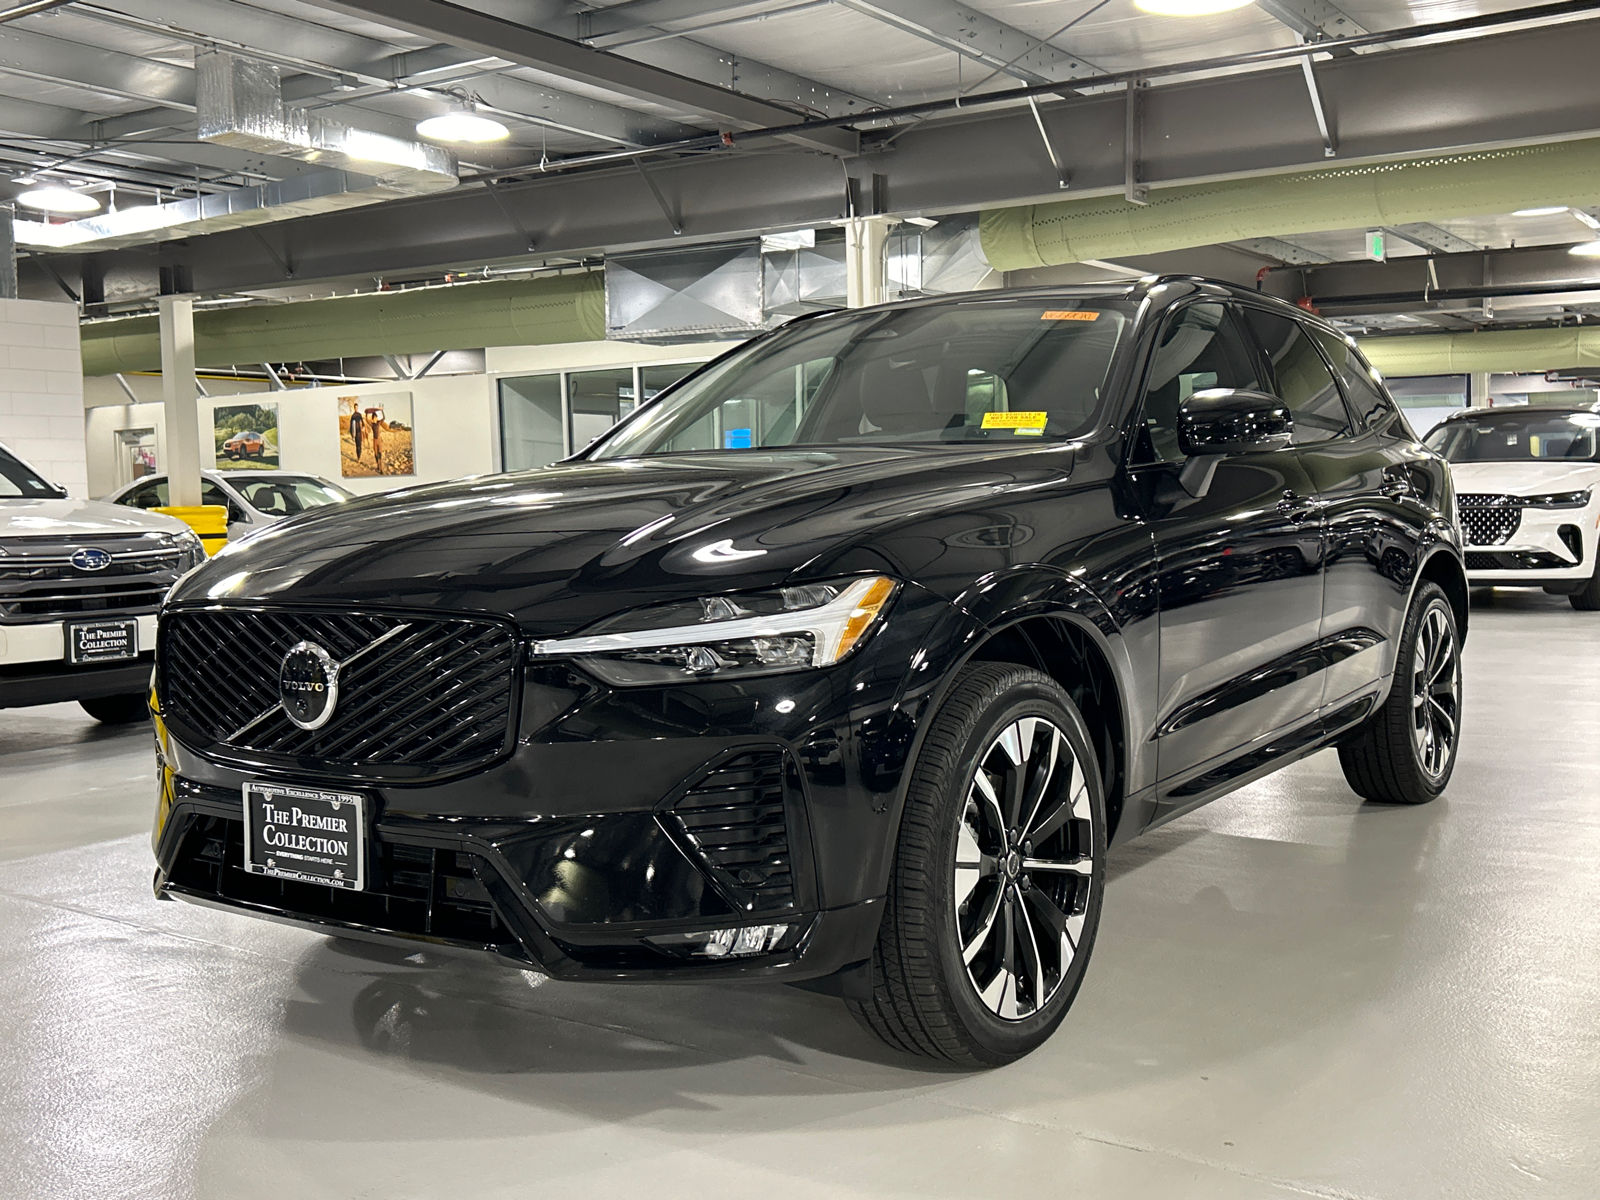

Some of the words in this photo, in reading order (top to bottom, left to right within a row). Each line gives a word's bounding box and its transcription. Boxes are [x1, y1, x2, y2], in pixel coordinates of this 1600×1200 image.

[80, 631, 96, 640] THE
[96, 630, 127, 639] PREMIER
[80, 638, 128, 650] COLLECTION
[283, 680, 325, 692] VOLVO
[262, 803, 290, 825] THE
[291, 807, 348, 833] PREMIER
[263, 825, 348, 856] COLLECTION
